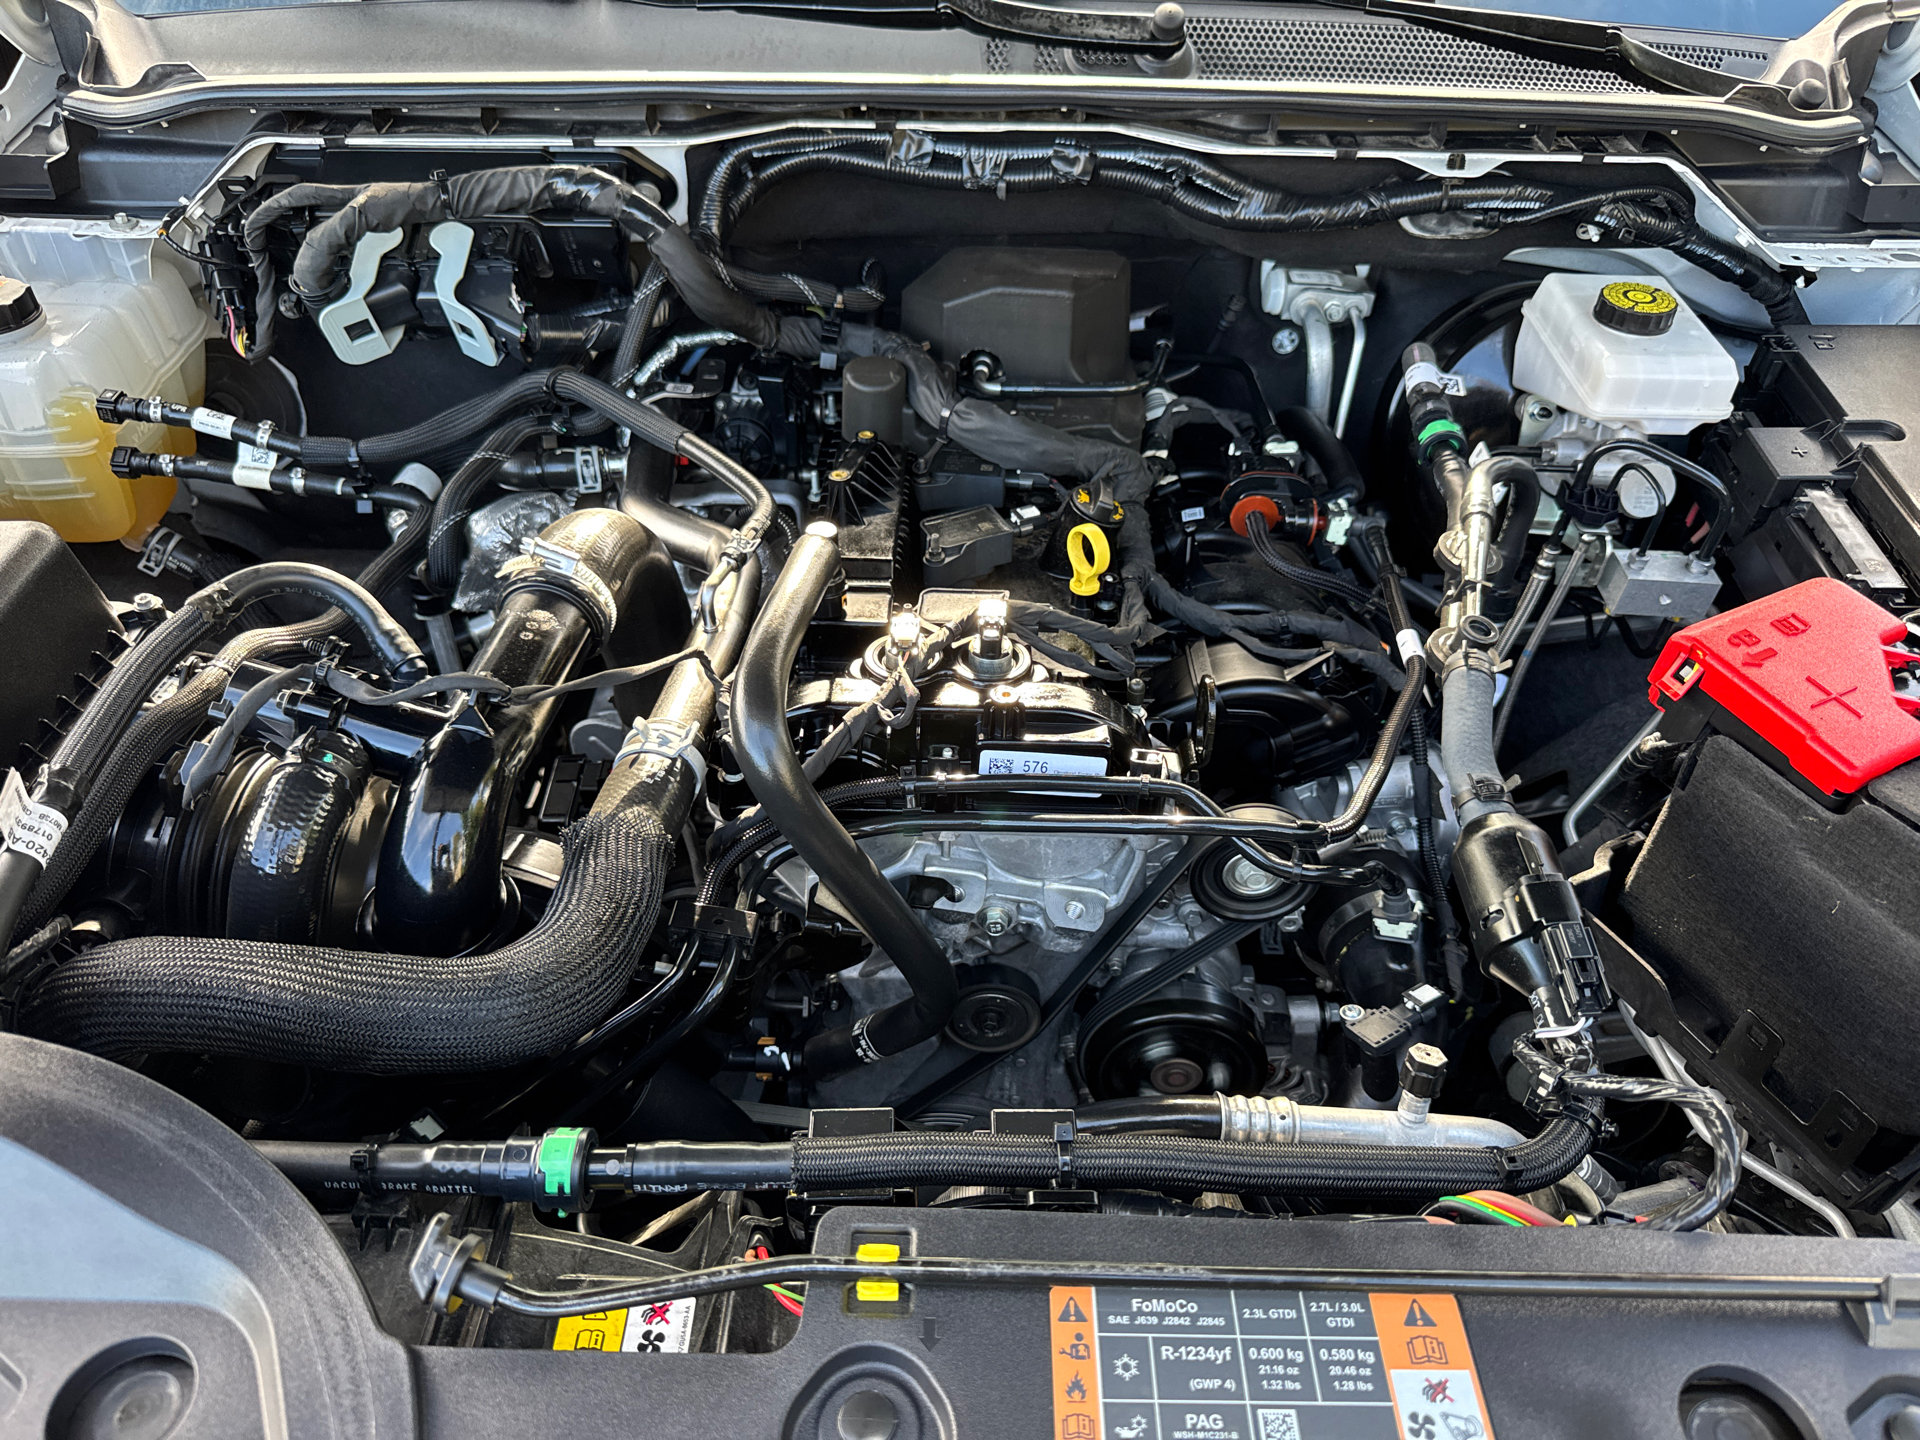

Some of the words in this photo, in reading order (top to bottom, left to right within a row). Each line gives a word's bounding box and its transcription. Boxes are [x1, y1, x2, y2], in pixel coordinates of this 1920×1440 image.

[171, 403, 188, 413] UPR
[1022, 760, 1049, 774] 576
[324, 1181, 361, 1189] VACU
[425, 1184, 477, 1194] ARNITEL
[633, 1183, 688, 1193] ARNITE
[1132, 1298, 1198, 1313] FoMoCo
[1310, 1302, 1334, 1313] 2.7L
[1341, 1302, 1365, 1314] 3.0L
[1242, 1308, 1267, 1319] 2.3L
[1268, 1309, 1297, 1320] GTDI
[1108, 1315, 1130, 1325] SAE
[1134, 1316, 1158, 1325] J639
[1162, 1316, 1191, 1326] J2842
[1196, 1317, 1225, 1326] J2845
[1326, 1317, 1355, 1328] GTDI
[1161, 1345, 1232, 1365] R-1234yf
[1248, 1347, 1284, 1361] 0.600
[1286, 1348, 1304, 1363] kg
[1319, 1348, 1356, 1361] 0.580
[1357, 1349, 1376, 1364] kg
[1258, 1365, 1284, 1375] 21.16
[1286, 1367, 1300, 1375] oz
[1328, 1366, 1357, 1376] 20.46
[1358, 1368, 1372, 1376] oz
[1189, 1378, 1222, 1392] (GWP
[1223, 1379, 1236, 1392] 4)
[1261, 1380, 1283, 1390] 1.32
[1284, 1380, 1301, 1390] lbs
[1333, 1381, 1356, 1391] 1.28
[1357, 1381, 1374, 1391] lbs
[1185, 1413, 1224, 1430] PAG
